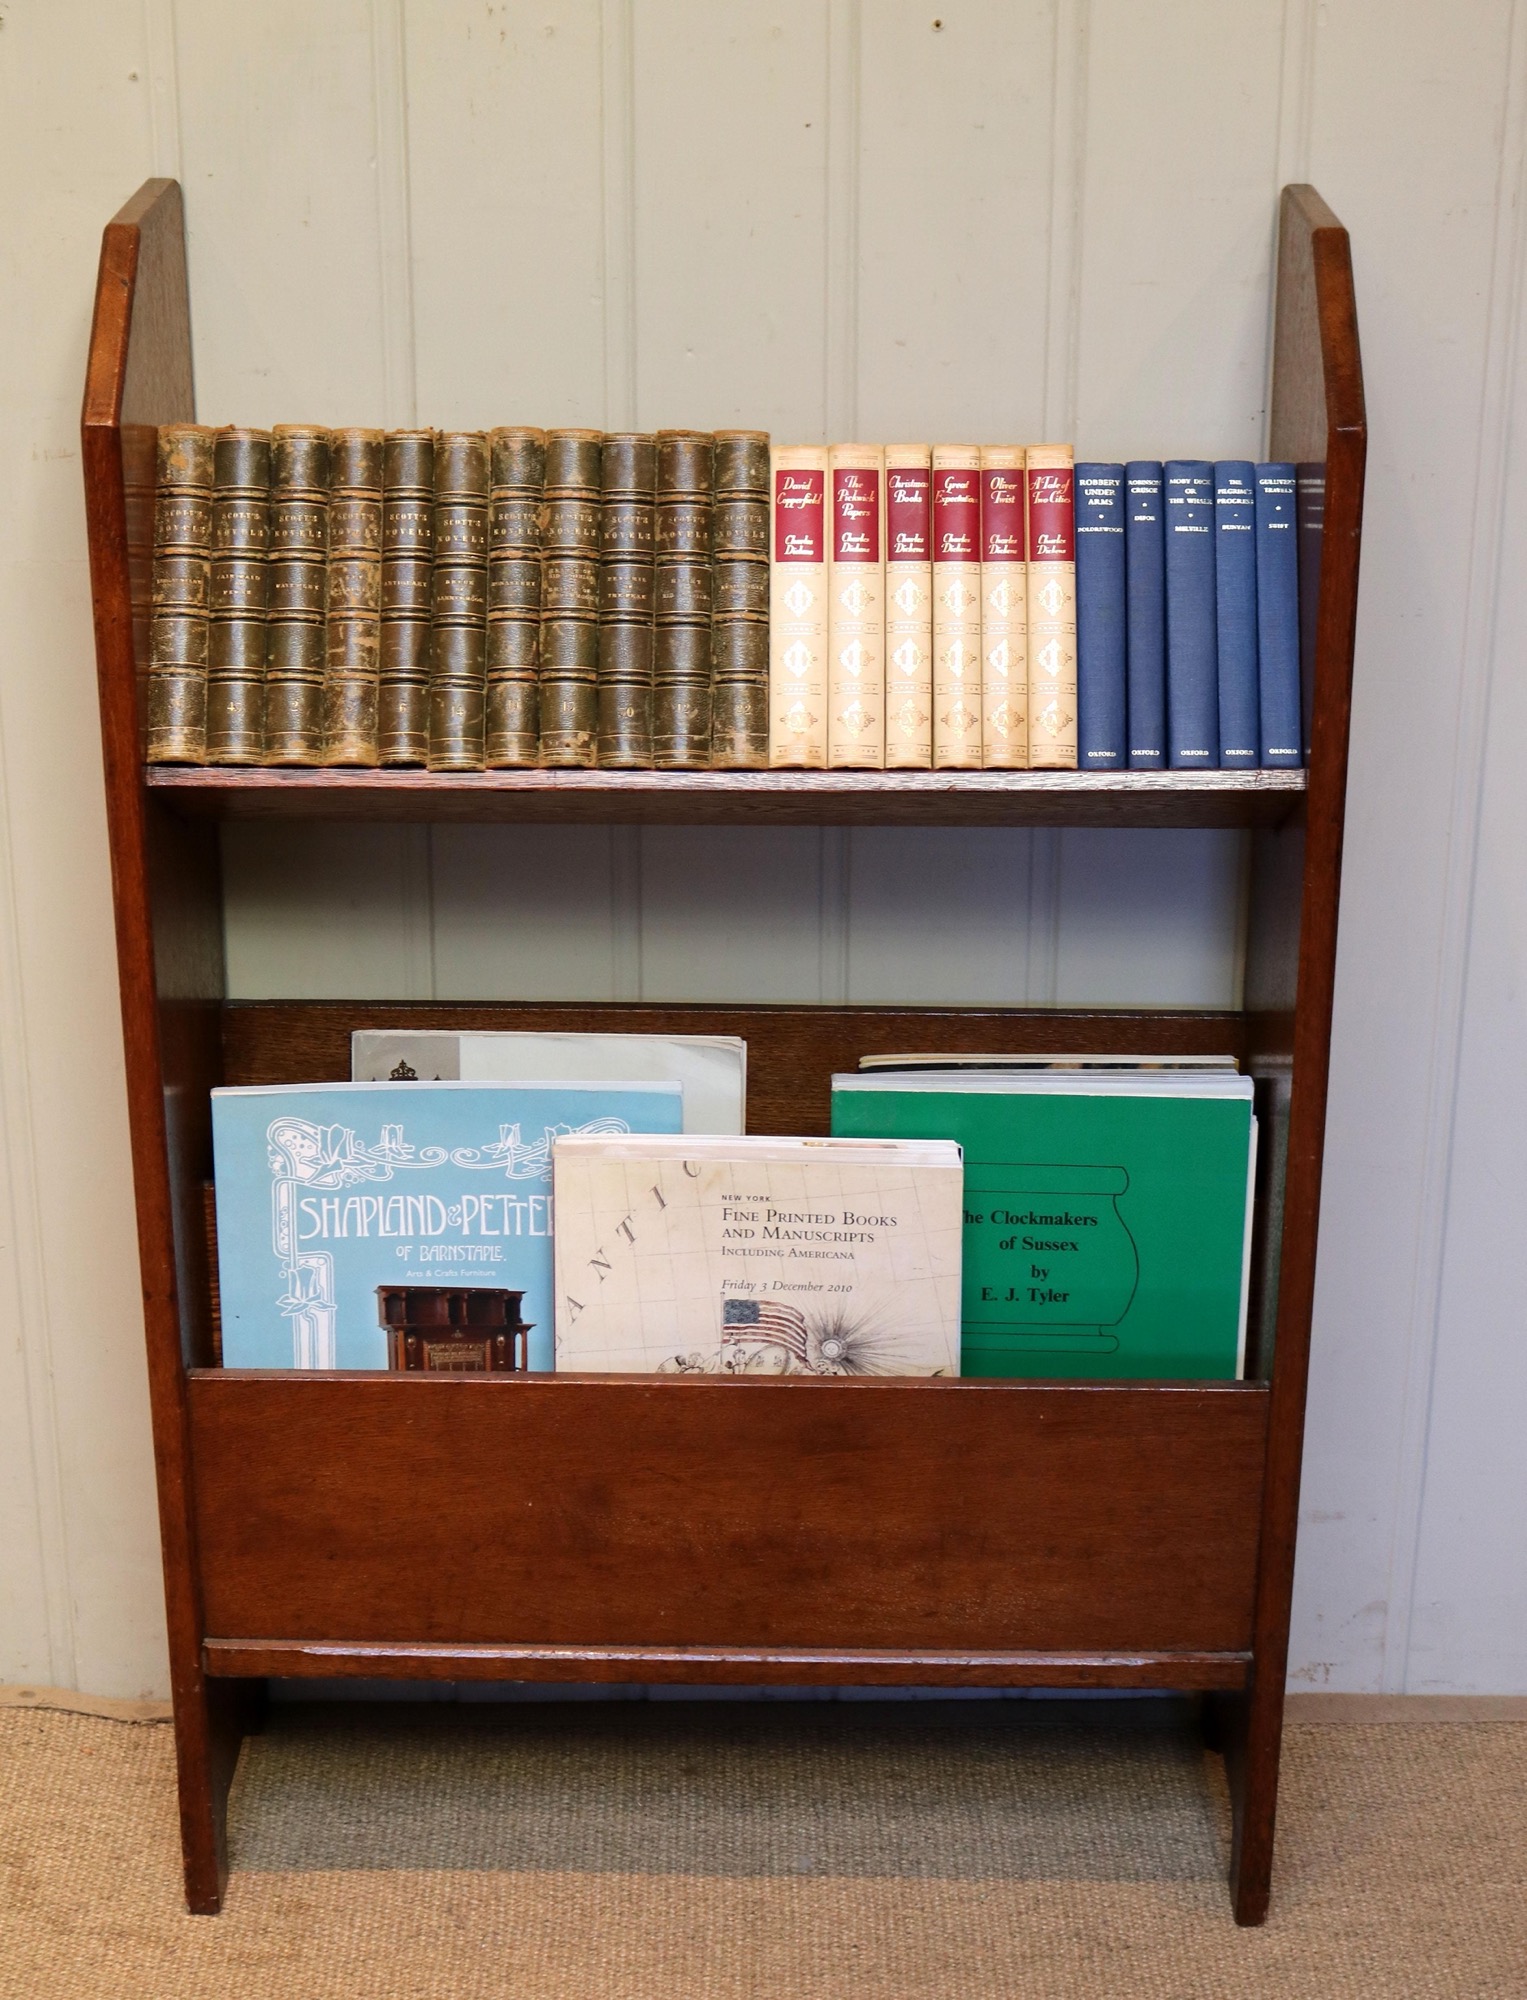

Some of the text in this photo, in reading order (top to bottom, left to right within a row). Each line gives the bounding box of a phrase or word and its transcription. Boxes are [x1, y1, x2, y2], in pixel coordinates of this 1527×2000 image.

[782, 476, 813, 490] David
[844, 475, 864, 488] The
[888, 475, 929, 488] Christmas
[944, 476, 970, 494] Great
[990, 476, 1018, 490] Oliver
[1040, 475, 1060, 490] Tale
[837, 489, 875, 502] Pickwick
[893, 489, 923, 503] Books
[990, 491, 1016, 504] Twist
[1032, 490, 1071, 504] Two Cities
[1084, 488, 1116, 496] UNDER
[777, 492, 822, 509] Copperfield
[1088, 498, 1114, 506] ARMS
[389, 513, 428, 521] SCOTT'S
[499, 513, 537, 521] SCOTT'S
[841, 503, 871, 520] Papers
[444, 519, 481, 527] SCOTT'S
[604, 531, 651, 540] NOVELS
[785, 534, 813, 545] Charles
[841, 532, 870, 543] Charles
[896, 532, 924, 543] Charles
[943, 532, 971, 543] Charles
[989, 534, 1018, 544] Charles
[1037, 534, 1066, 544] Charles
[784, 544, 814, 555] Dickens
[840, 542, 870, 553] Dickens
[893, 542, 924, 553] Dickens
[941, 543, 972, 553] Dickens
[988, 544, 1018, 554] Dickens
[1036, 544, 1066, 555] Dickens
[451, 705, 465, 717] 14
[299, 1195, 447, 1239] SHAPLAND
[990, 1210, 1098, 1226] Clockmakers
[722, 1228, 755, 1239] AND
[999, 1236, 1079, 1251] of Sussex
[396, 1245, 413, 1261] OF
[406, 1269, 496, 1277] Arts & Crafts Furniture
[1031, 1265, 1049, 1281] by
[721, 1279, 853, 1293] Friday 3 December 2010
[981, 1287, 1070, 1305] E. J. Tyler
